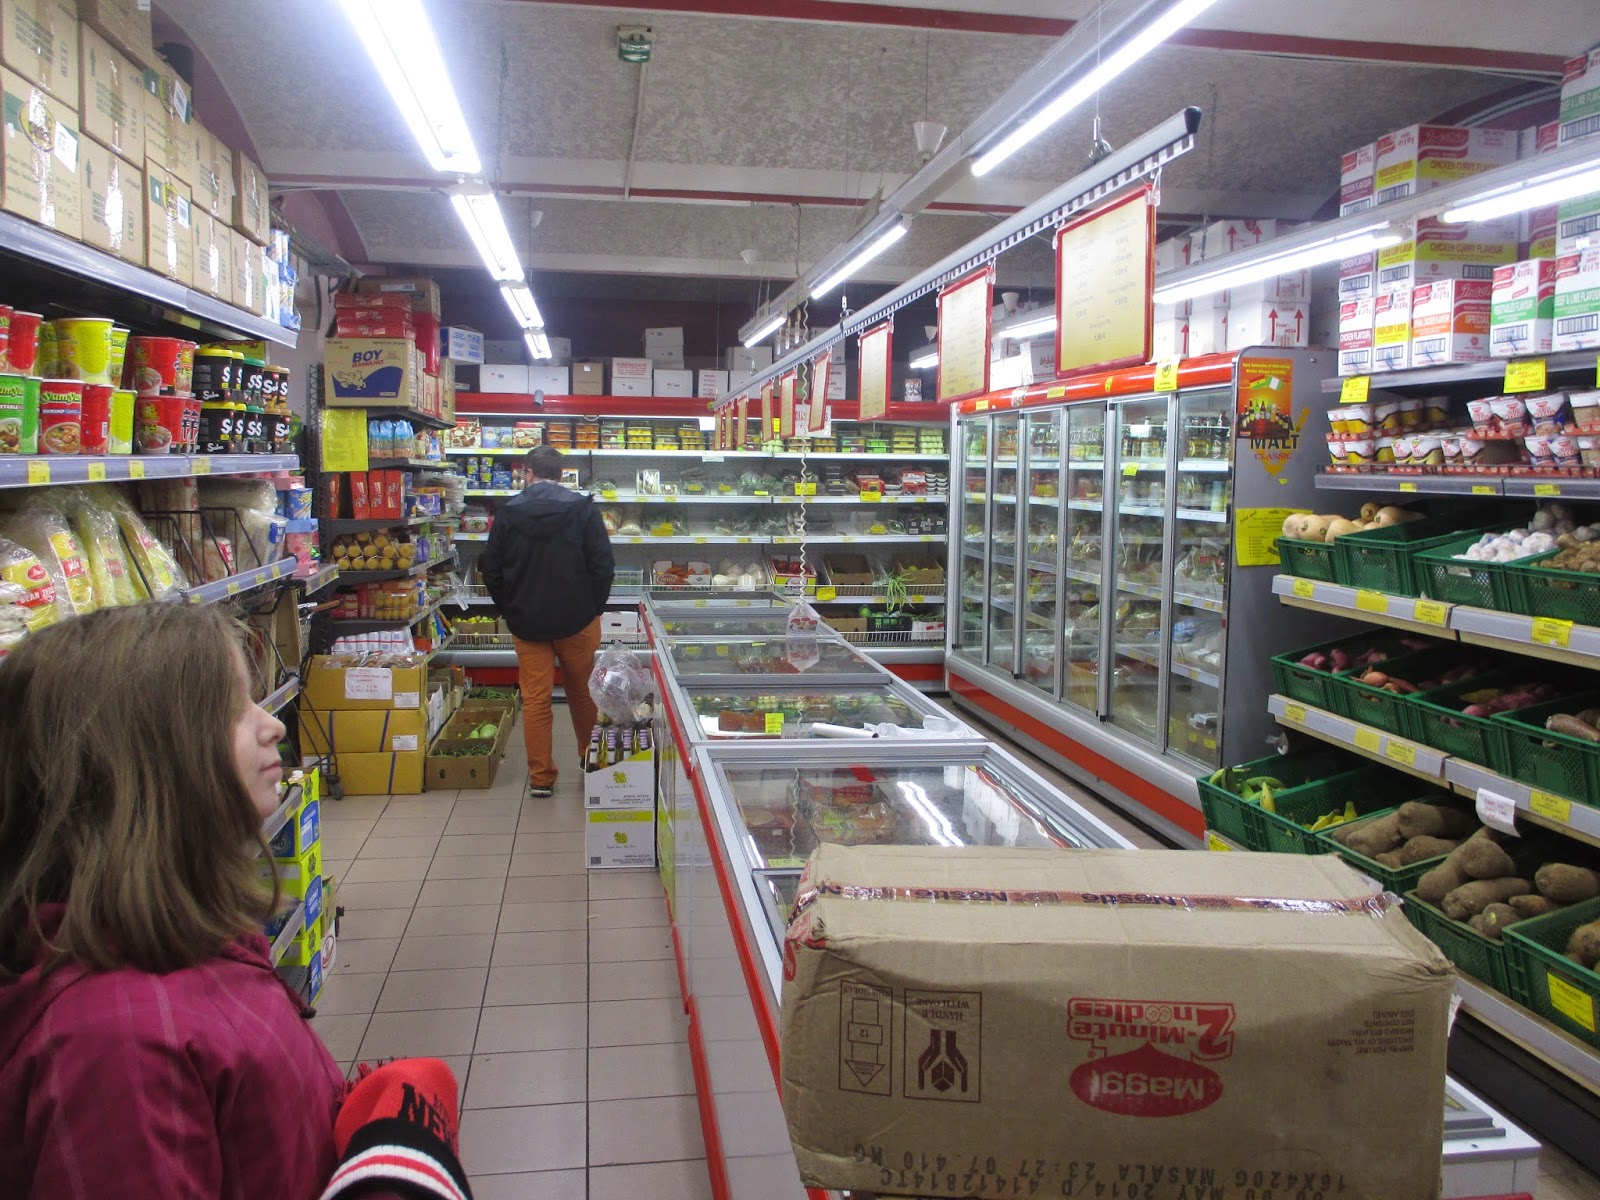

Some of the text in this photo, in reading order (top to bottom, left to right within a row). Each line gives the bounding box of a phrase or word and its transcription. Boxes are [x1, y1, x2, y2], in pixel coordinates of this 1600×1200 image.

[352, 349, 384, 363] BOY
[1250, 434, 1300, 450] MALT
[921, 1009, 963, 1020] HANDLE
[859, 1029, 870, 1038] 12
[1089, 1069, 1204, 1103] Maggi
[1118, 1162, 1215, 1187] MASALA
[1234, 1170, 1346, 1192] 16X420G
[1177, 1184, 1223, 1200] MAY
